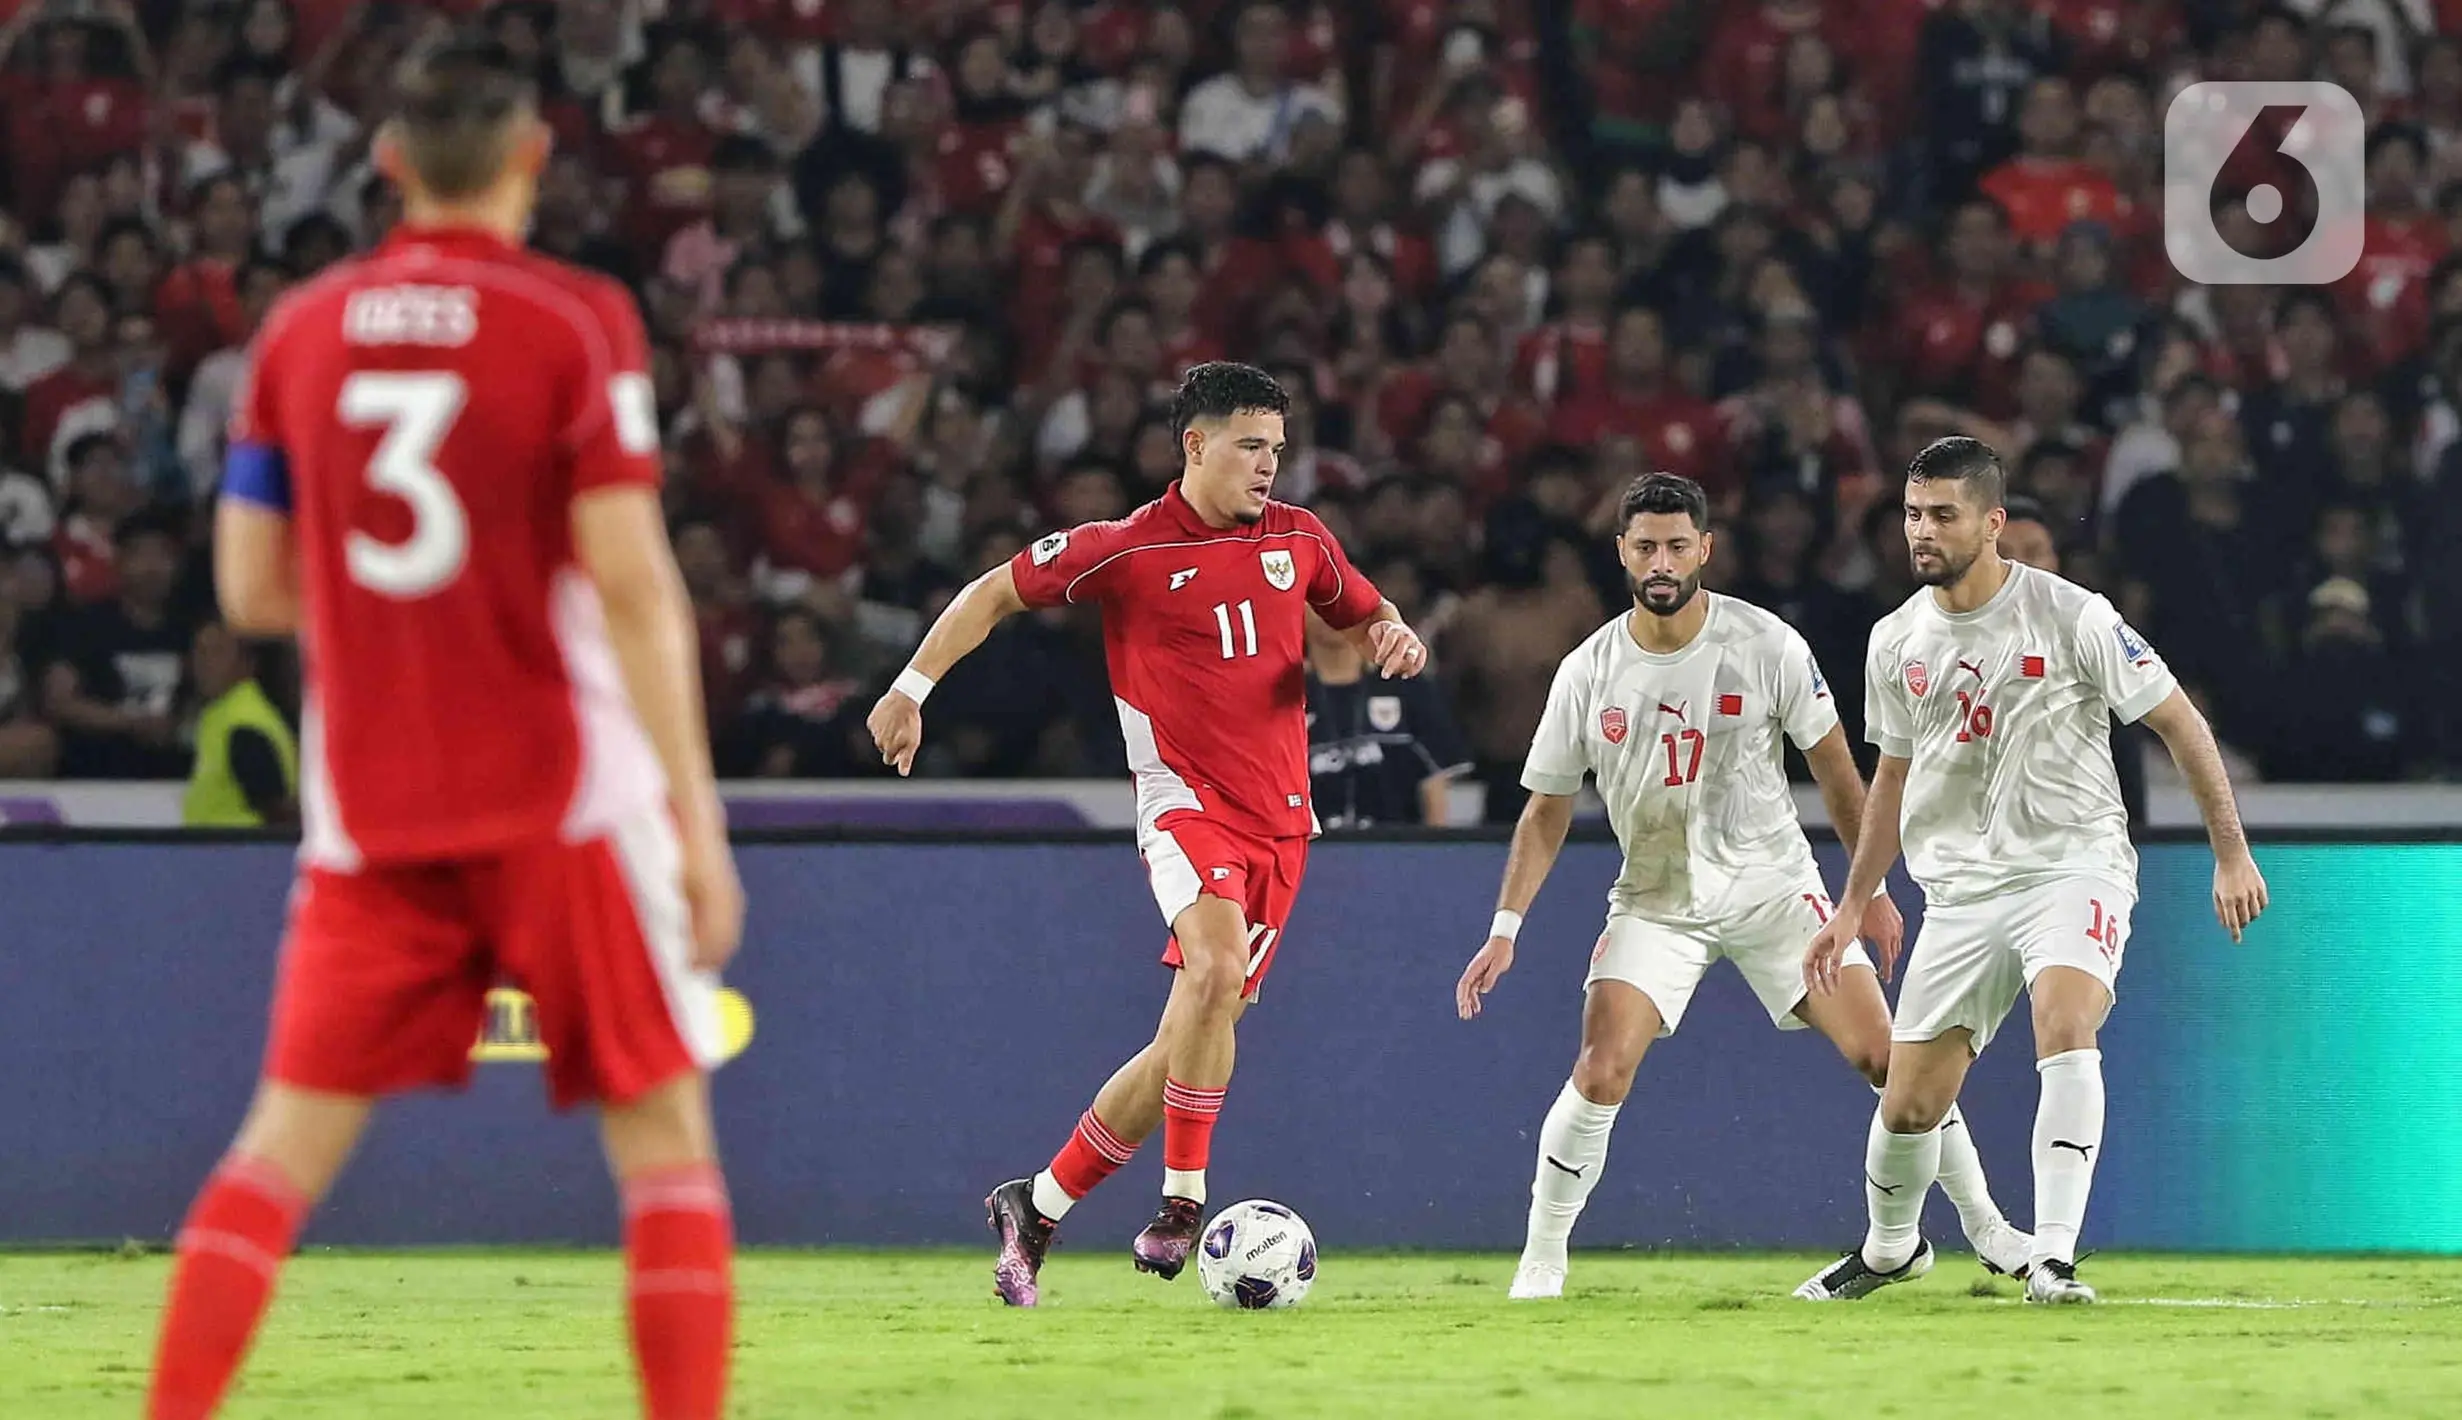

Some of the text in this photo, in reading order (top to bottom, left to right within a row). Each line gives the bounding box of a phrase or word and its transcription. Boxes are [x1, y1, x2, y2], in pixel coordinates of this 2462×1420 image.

[337, 370, 470, 598] 3
[1212, 599, 1259, 660] 11
[1956, 688, 1993, 742] 16
[1661, 728, 1705, 787] 17
[2086, 898, 2118, 955] 16
[1245, 1231, 1288, 1262] molten
